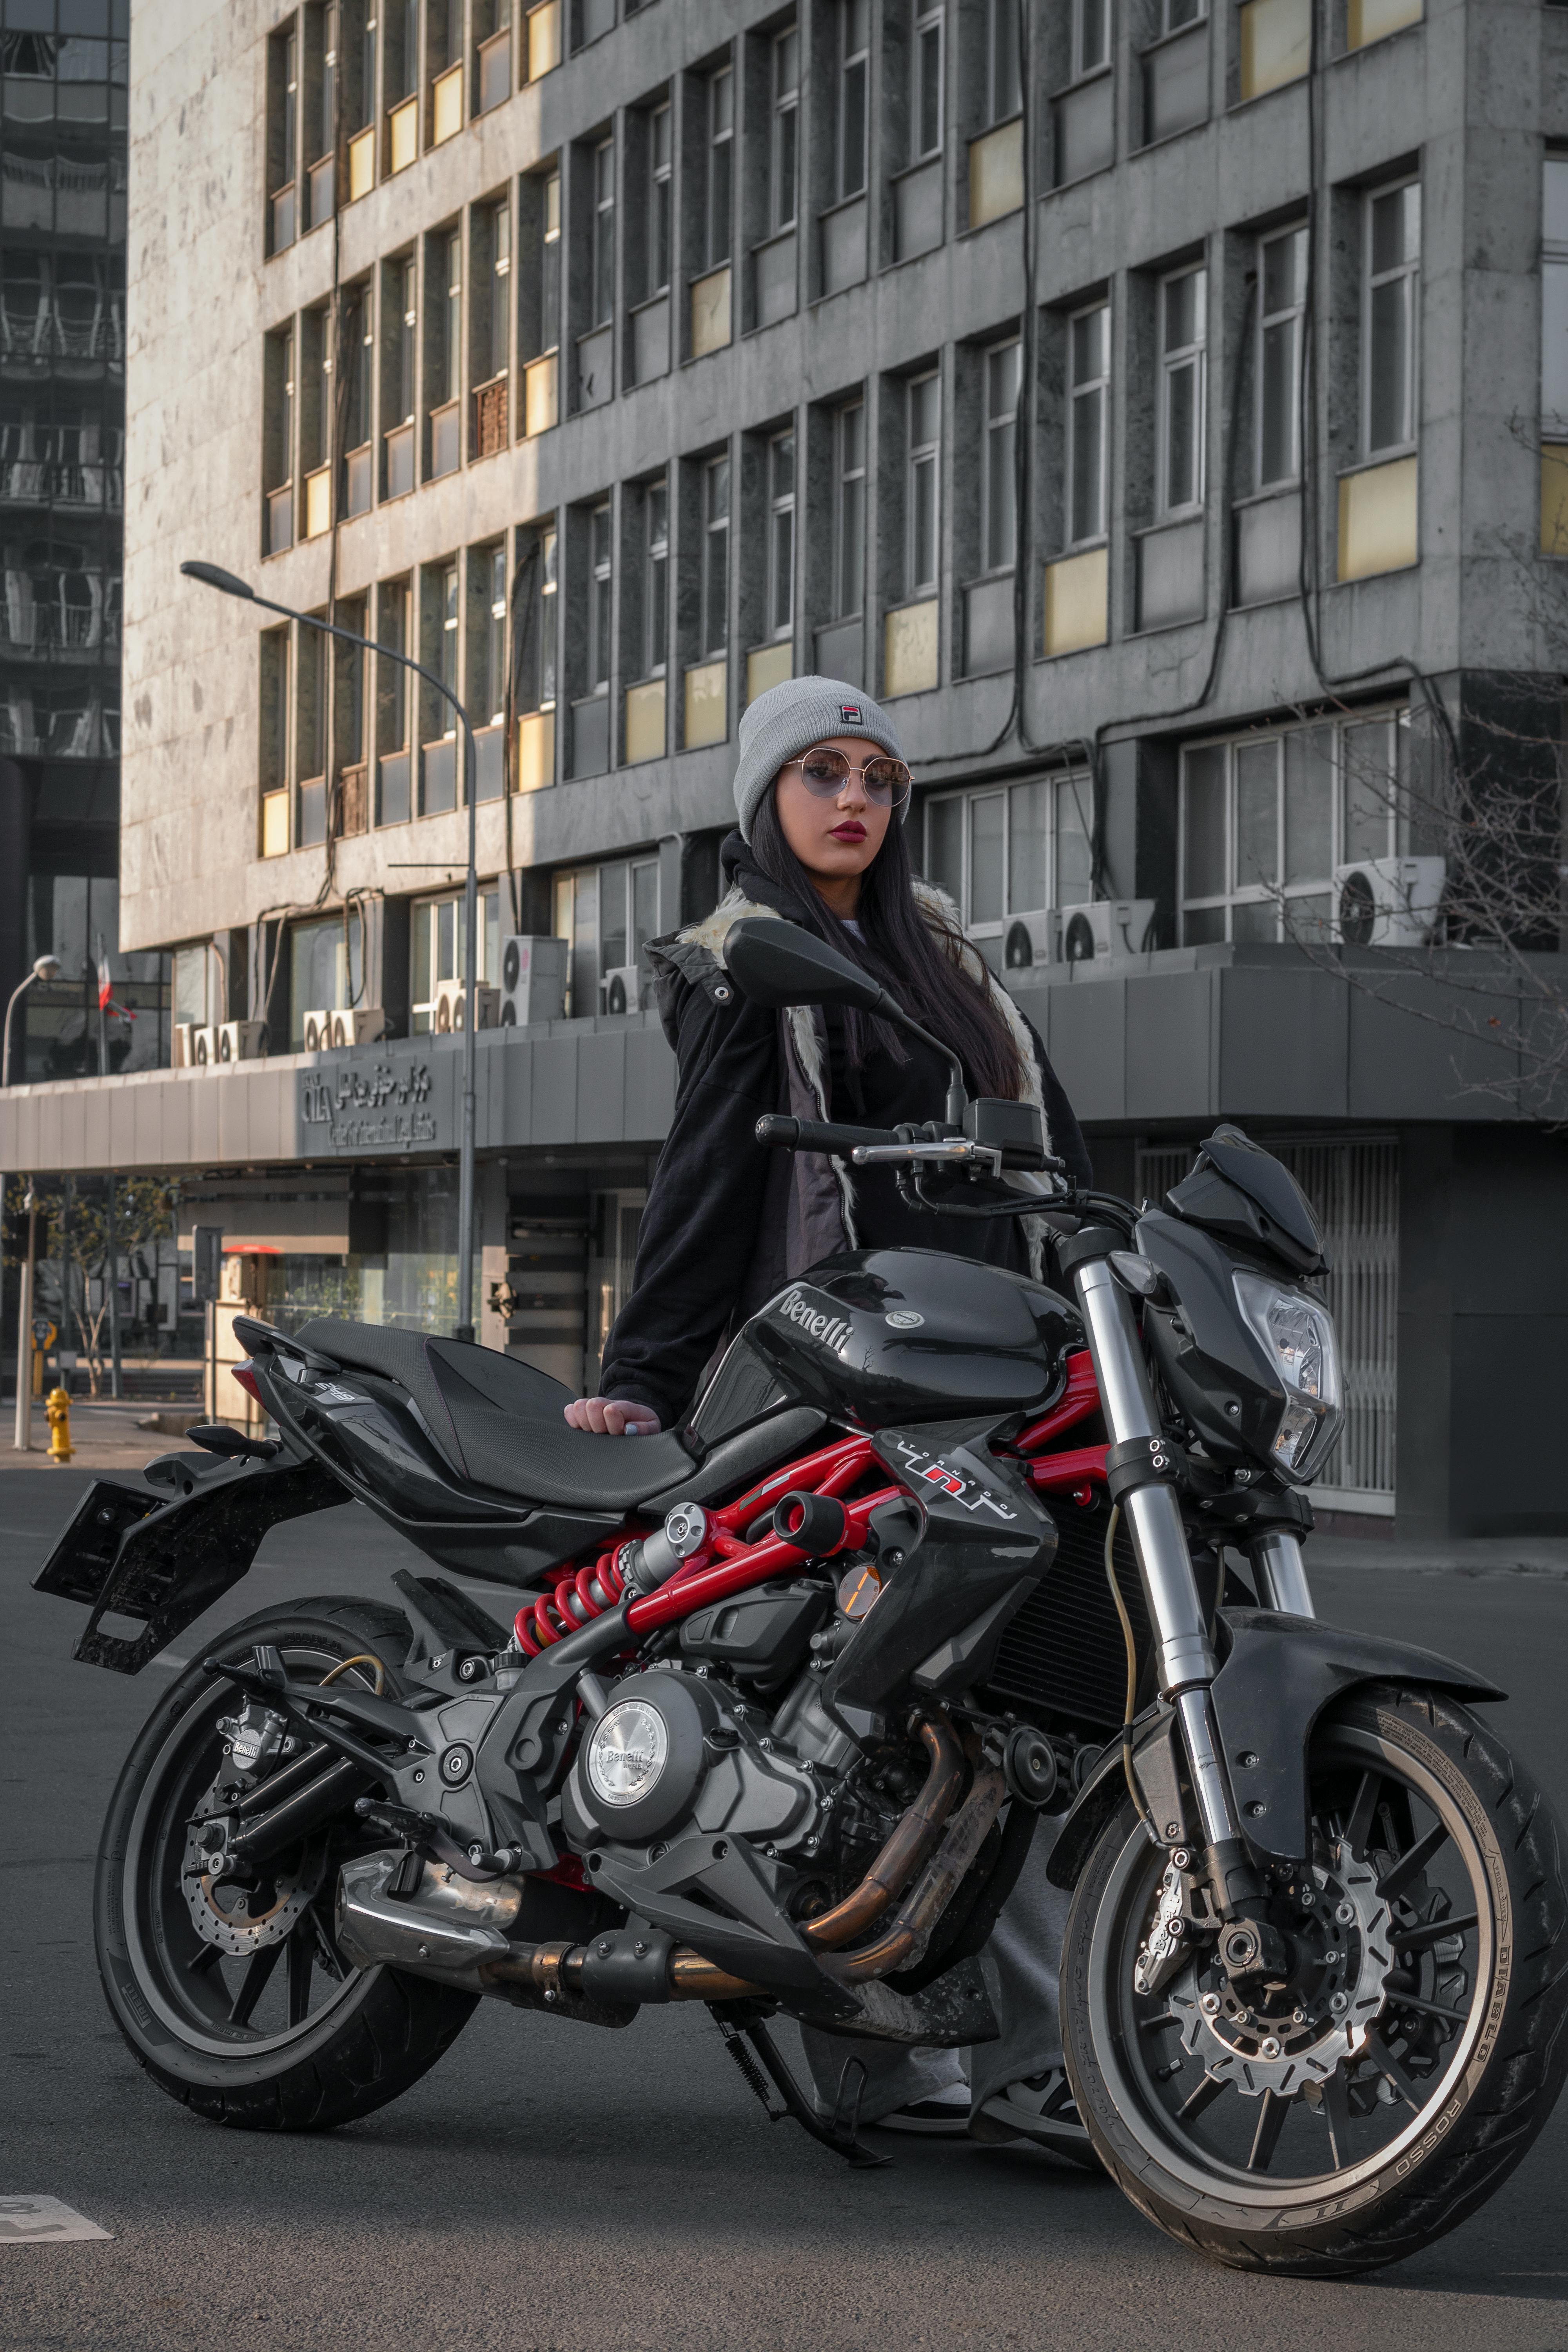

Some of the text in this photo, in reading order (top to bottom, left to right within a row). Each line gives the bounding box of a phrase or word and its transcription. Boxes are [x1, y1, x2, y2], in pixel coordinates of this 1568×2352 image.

[780, 1290, 854, 1353] Benelli
[897, 1313, 915, 1321] Benelli
[909, 1444, 1008, 1510] TORNADO
[840, 1530, 849, 1544] Benelli
[285, 1632, 342, 1651] DIABLO
[234, 1742, 257, 1757] Benelli
[606, 1749, 643, 1762] Benelli
[1494, 1866, 1503, 1893] FRONT
[122, 1981, 152, 2029] PIRELLI
[1312, 1946, 1510, 2221] DIABLO ROSSO II
